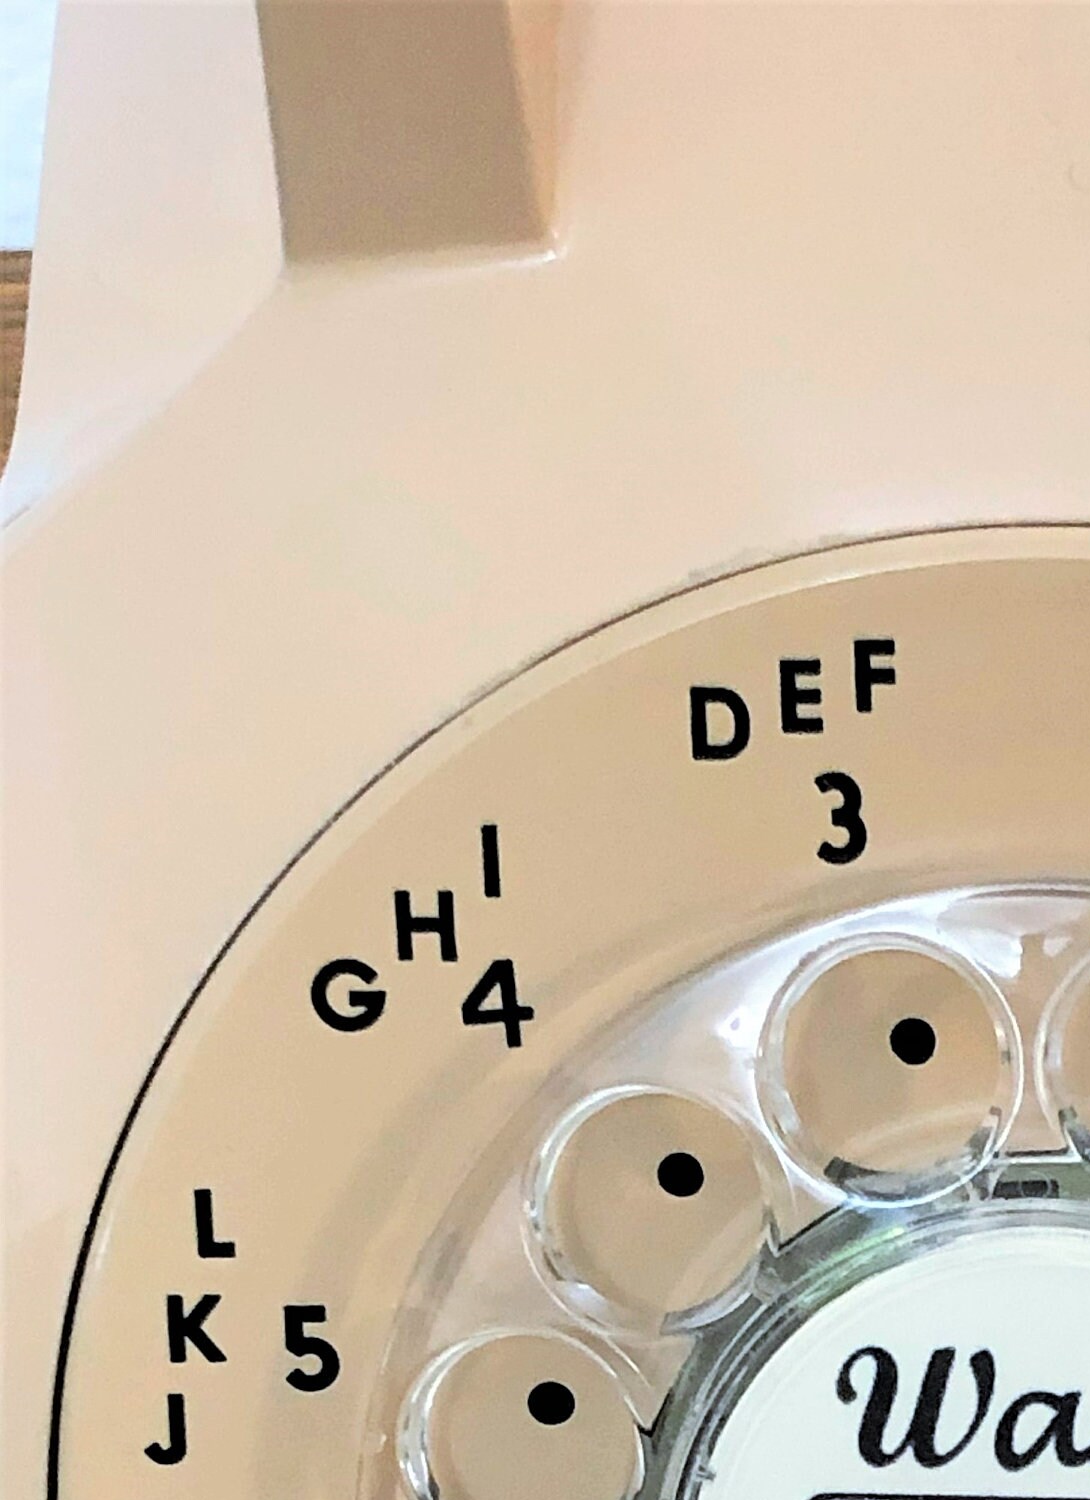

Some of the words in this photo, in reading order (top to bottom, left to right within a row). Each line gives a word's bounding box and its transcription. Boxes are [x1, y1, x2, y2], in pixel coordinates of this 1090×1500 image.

[813, 770, 868, 866] 3
[460, 957, 536, 1050] 4
[282, 1303, 341, 1393] 5
